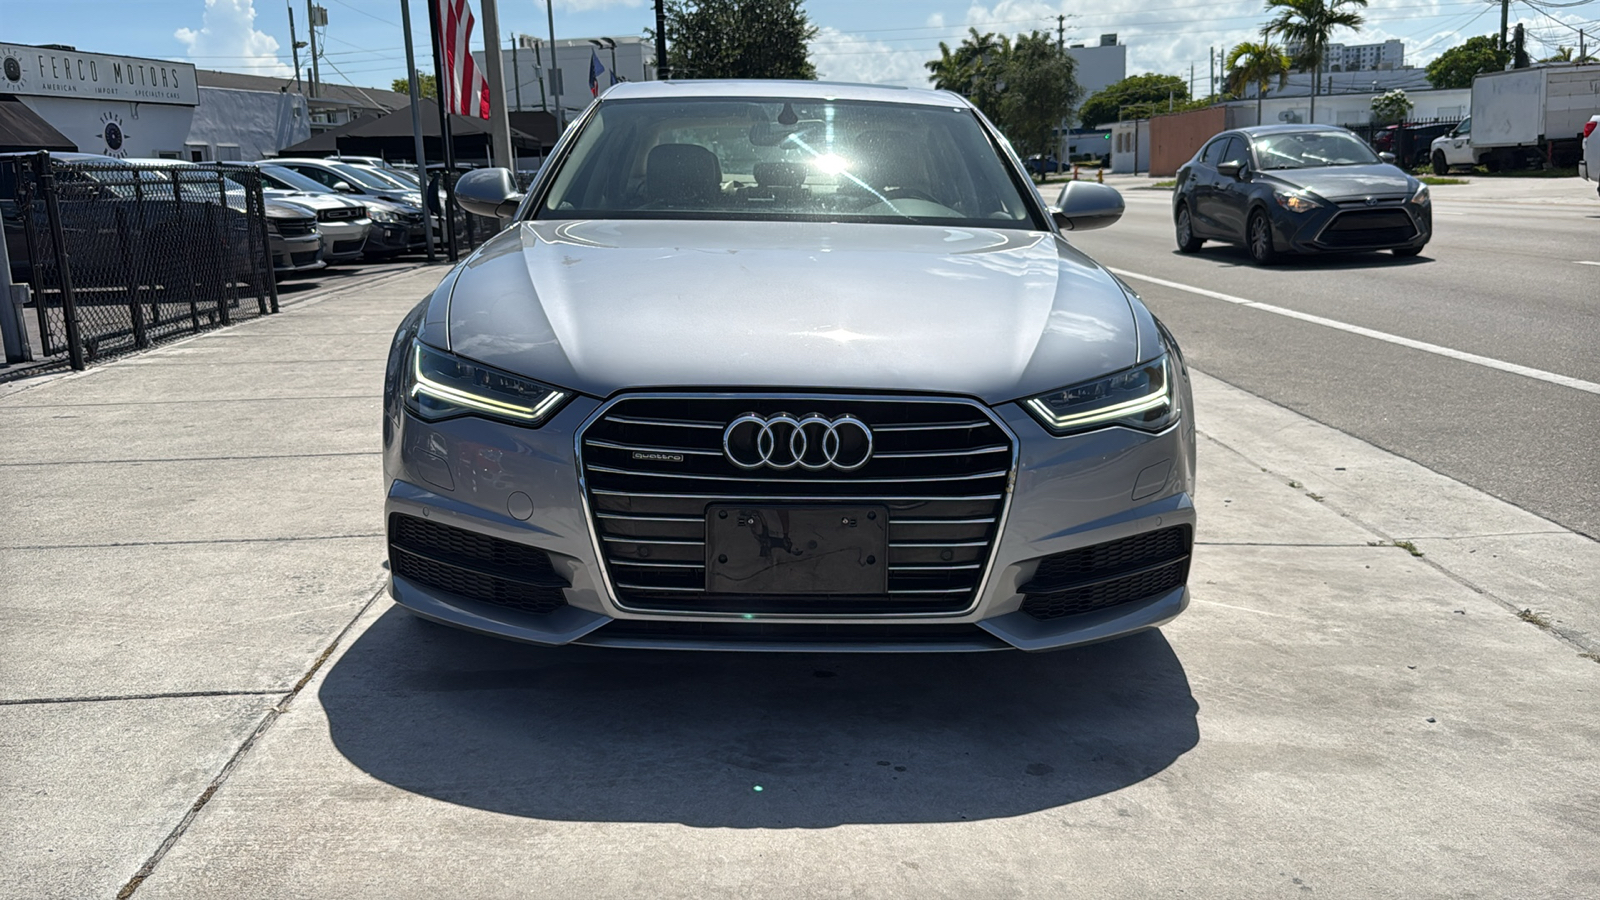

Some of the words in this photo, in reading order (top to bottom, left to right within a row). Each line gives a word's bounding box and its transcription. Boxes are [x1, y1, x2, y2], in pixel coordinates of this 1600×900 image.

[37, 55, 98, 82] FERCO
[113, 62, 179, 89] MOTORS
[42, 83, 77, 93] AMERICAN
[94, 87, 119, 95] IMPORT
[134, 89, 164, 98] SPECIALTY
[634, 452, 682, 461] quattro
